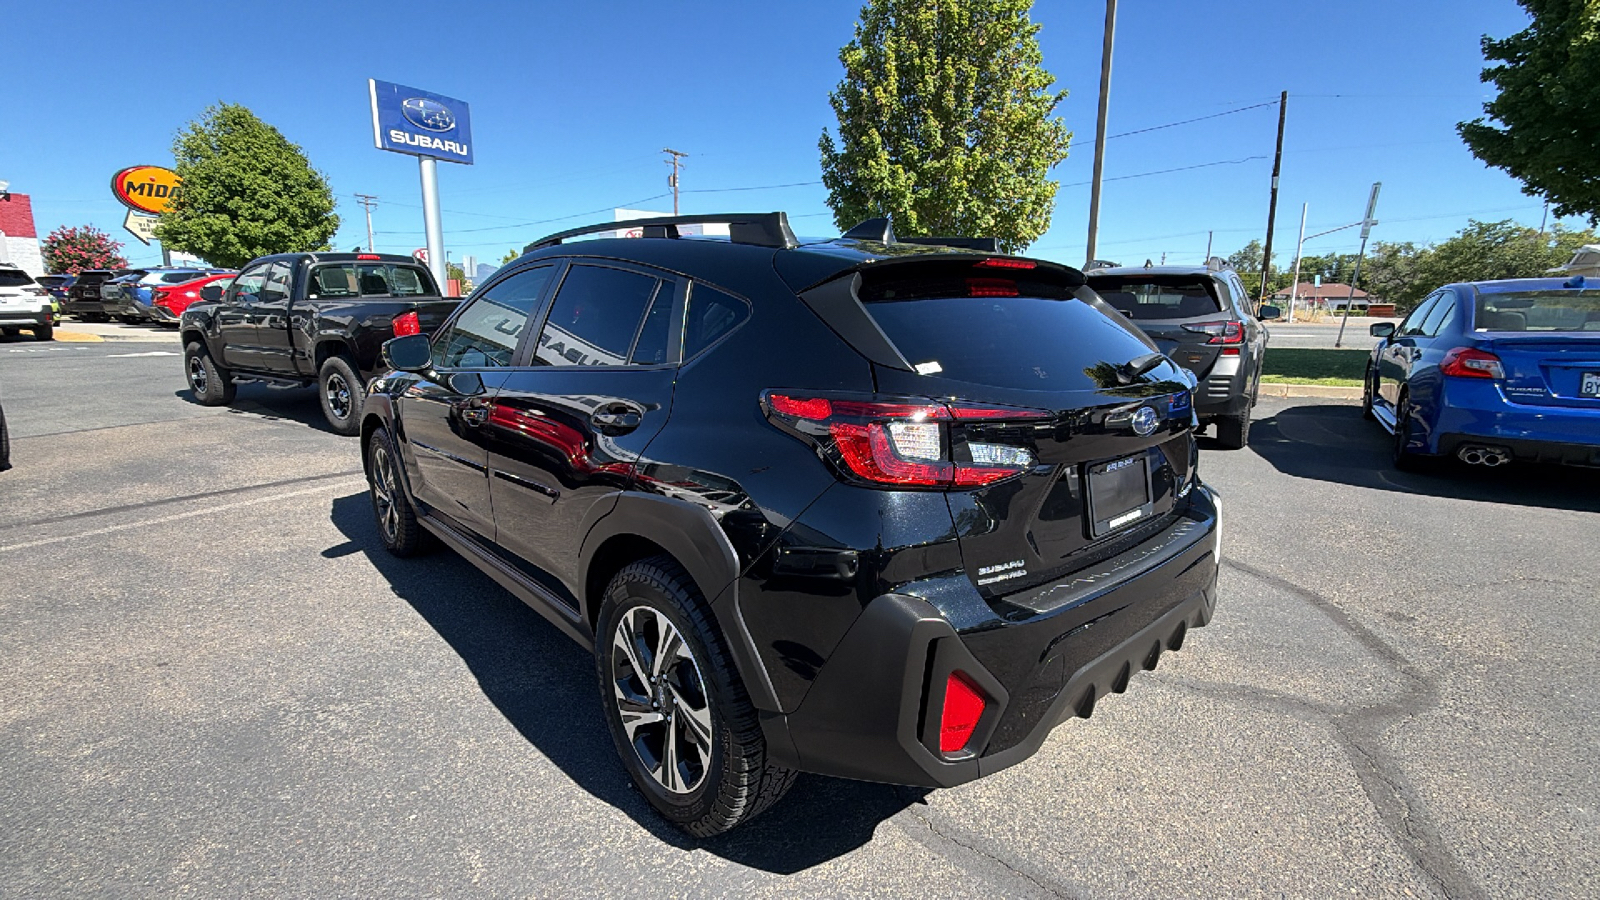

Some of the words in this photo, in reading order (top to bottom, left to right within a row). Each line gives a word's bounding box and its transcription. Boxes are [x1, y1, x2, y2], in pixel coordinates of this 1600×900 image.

[390, 129, 467, 156] SUBARU
[125, 181, 181, 198] MIDA
[978, 560, 1025, 575] SUBARU
